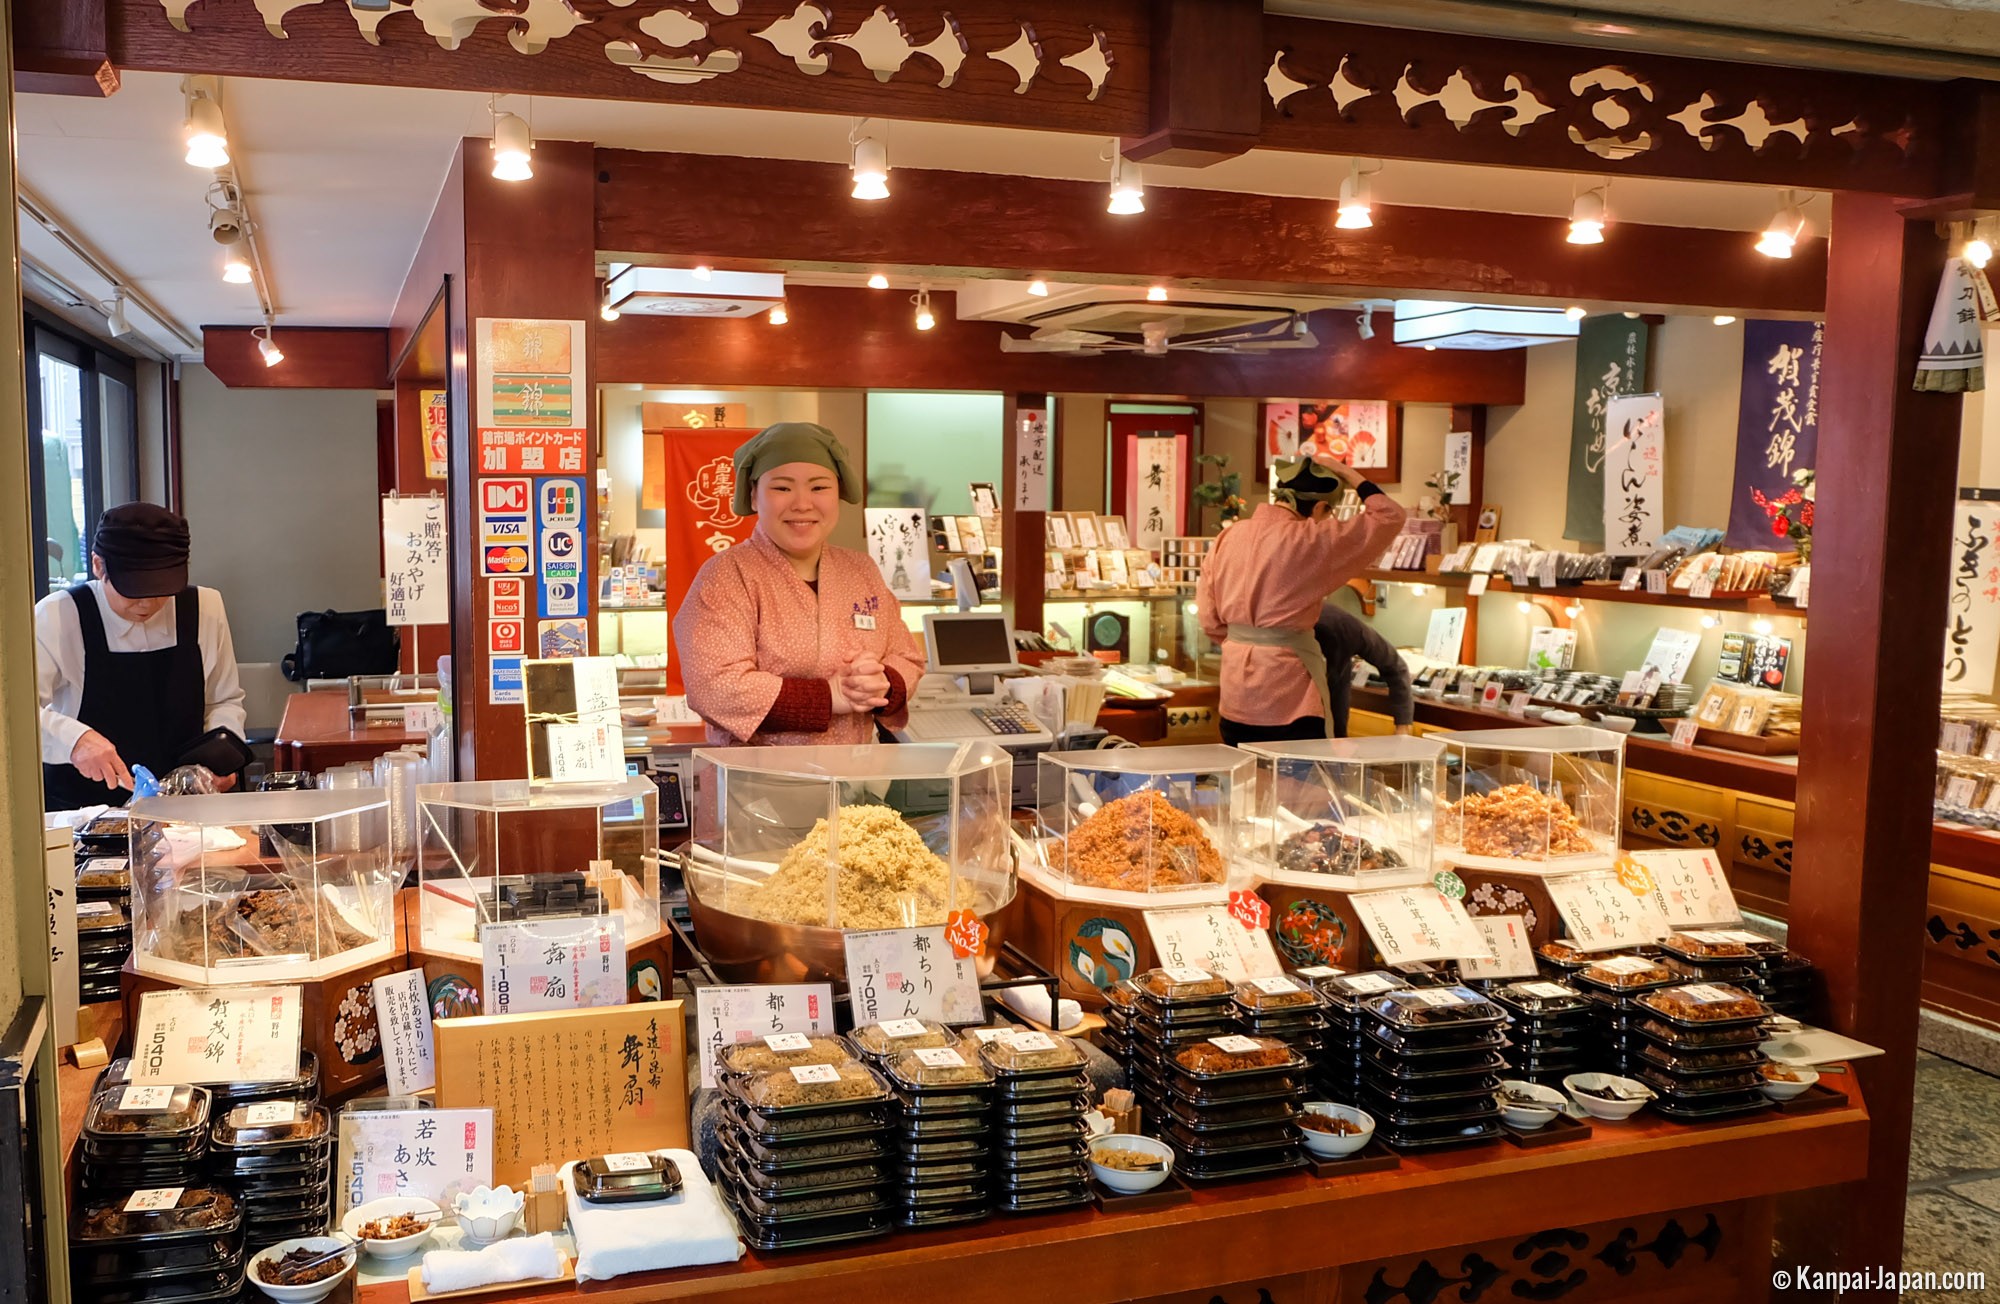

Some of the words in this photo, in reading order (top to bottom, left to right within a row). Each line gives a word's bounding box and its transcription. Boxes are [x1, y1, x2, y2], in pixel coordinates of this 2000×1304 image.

[516, 382, 543, 416] 錦
[1766, 344, 1803, 478] 賀茂錦
[482, 431, 582, 445] 錦市場ポイントカード
[483, 447, 582, 470] 加盟店
[1032, 421, 1044, 476] 地方配送
[487, 485, 524, 509] DC
[1144, 463, 1165, 533] 舞扇
[493, 524, 520, 533] VISA
[407, 532, 425, 601] おみやげ
[487, 556, 527, 564] MasterCard
[1945, 515, 1989, 683] ふきのとう
[1678, 858, 1700, 900] しめじ
[1234, 906, 1261, 926] No.1
[1236, 894, 1262, 915] 人気
[1400, 895, 1440, 950] 松茸昆布
[1603, 881, 1631, 922] くるみ
[949, 930, 979, 953] No.2
[951, 915, 980, 939] 人気
[543, 942, 567, 998] 舞扇
[913, 934, 933, 995] 都ちり
[765, 992, 784, 1032] 都ち
[863, 974, 878, 1019] 702円
[900, 979, 919, 1016] めん
[204, 998, 230, 1063] 賀茂錦
[149, 1033, 165, 1076] 540円
[618, 1034, 643, 1111] 舞扇
[415, 1118, 437, 1166] 若炊
[466, 1152, 474, 1173] 野村
[394, 1144, 411, 1196] あさ
